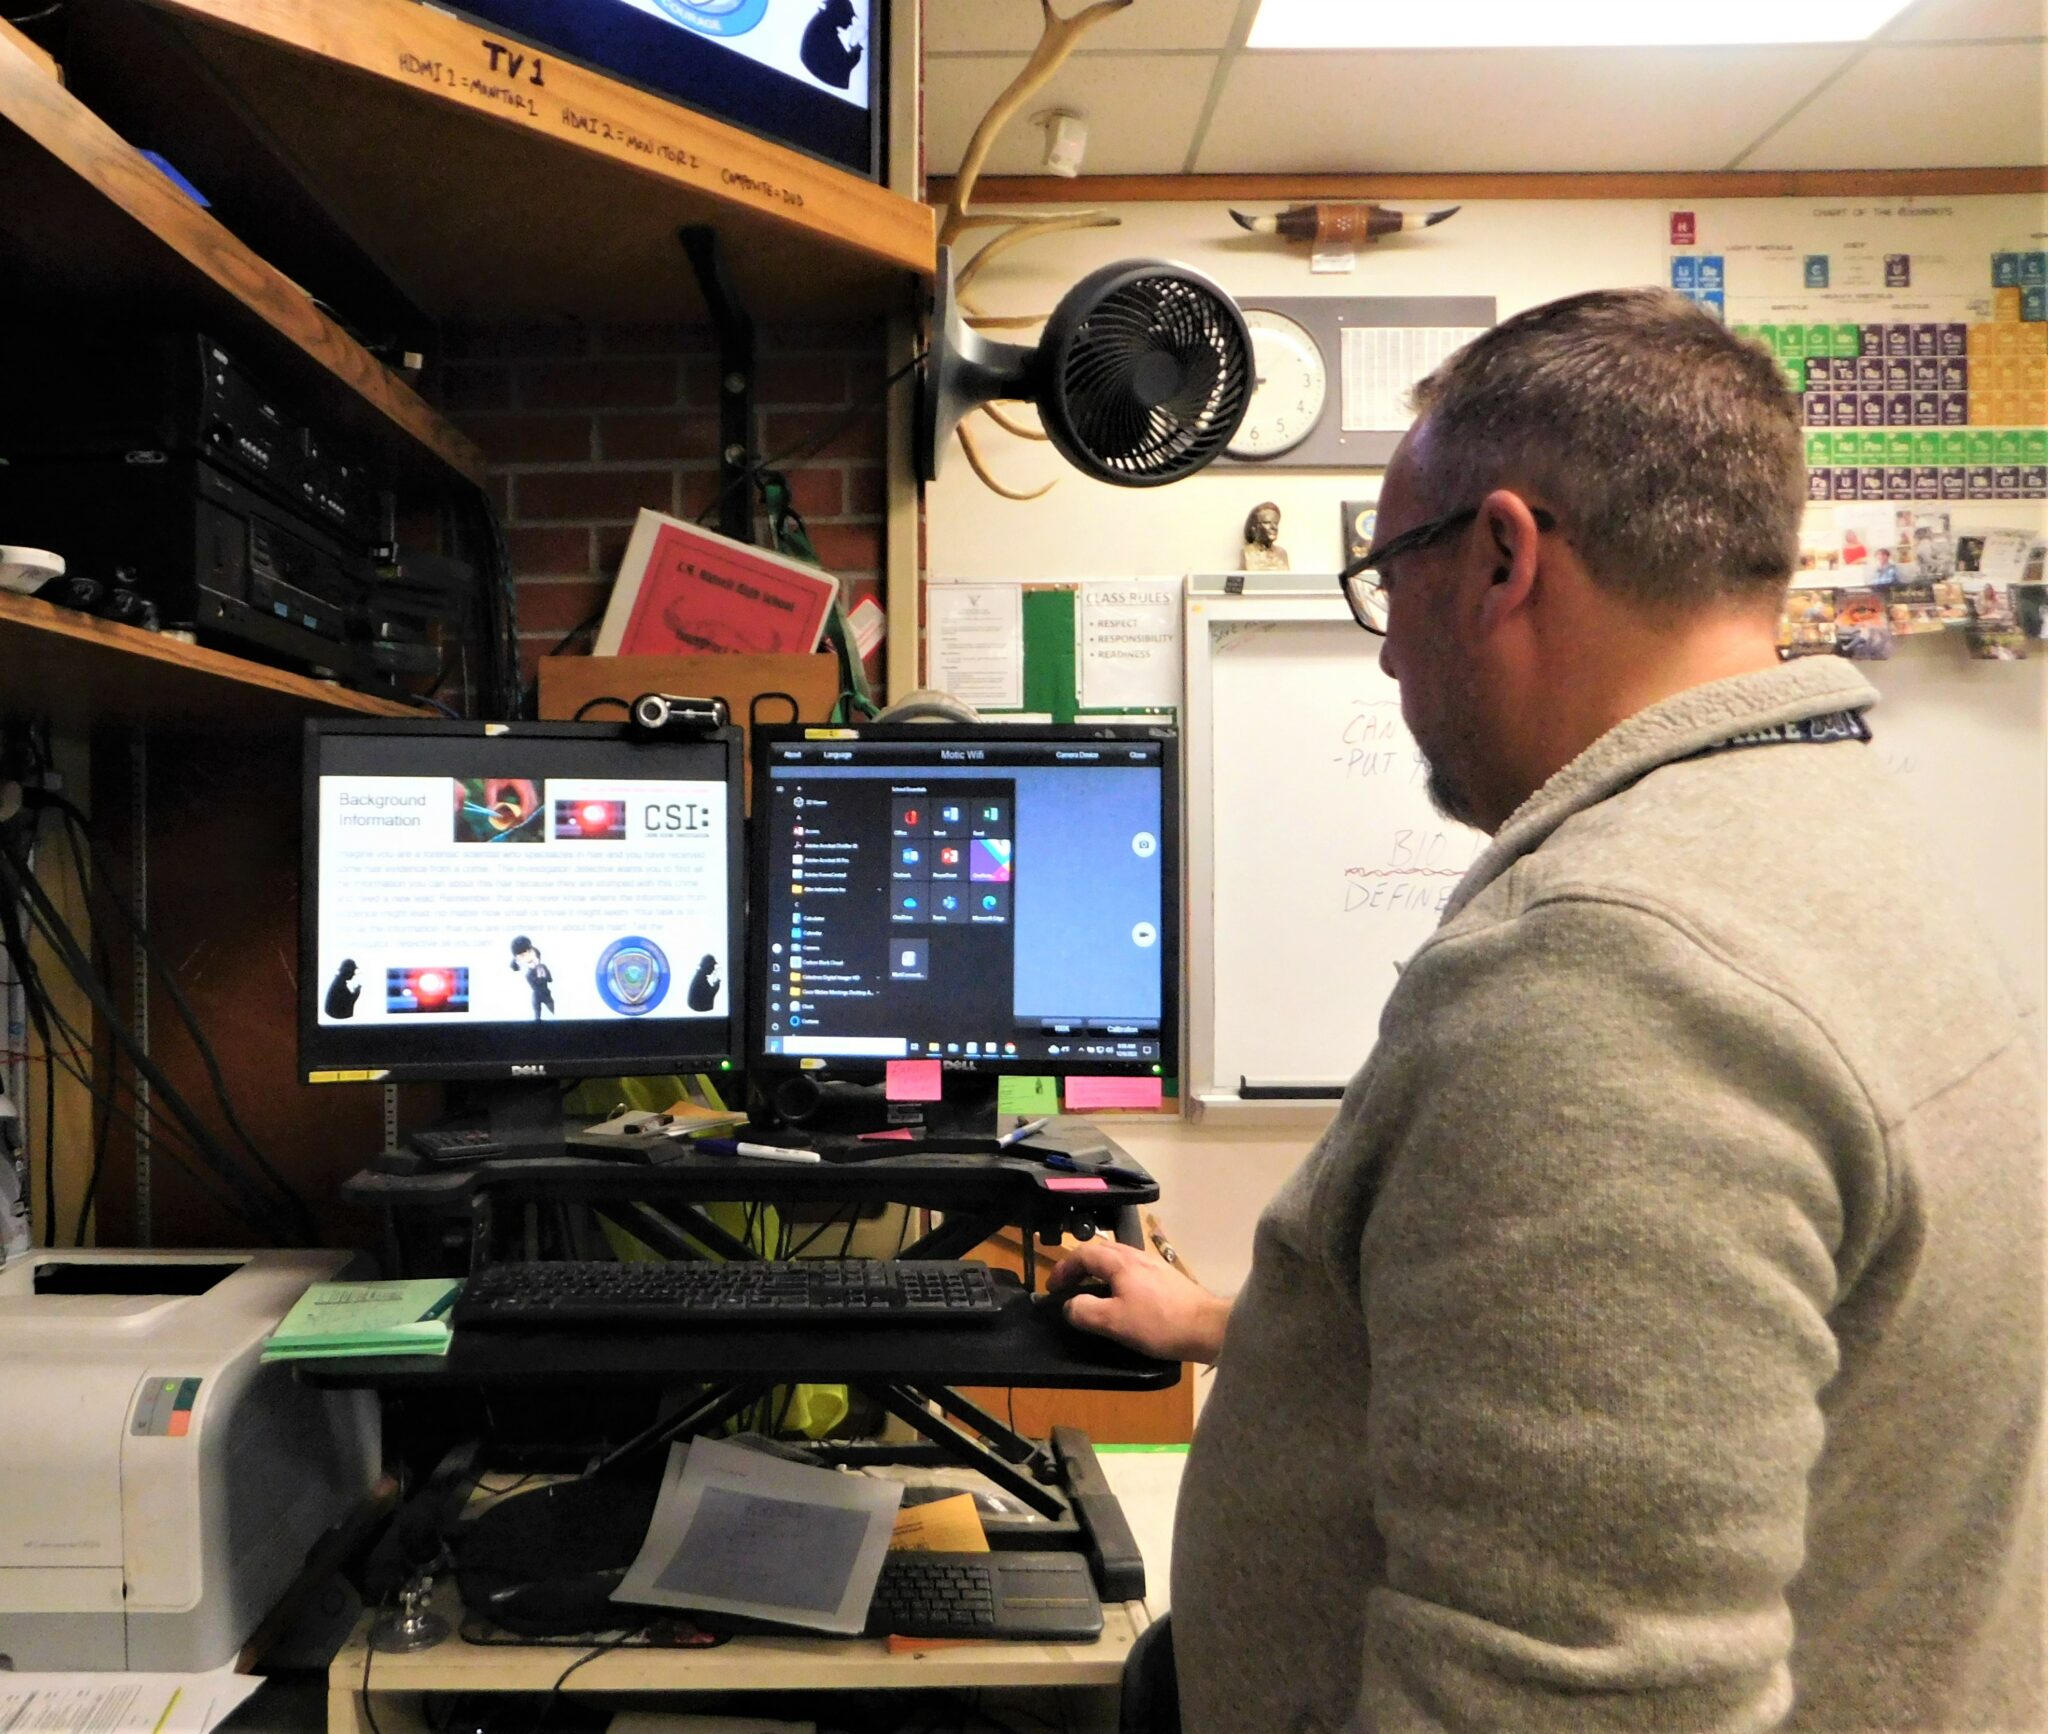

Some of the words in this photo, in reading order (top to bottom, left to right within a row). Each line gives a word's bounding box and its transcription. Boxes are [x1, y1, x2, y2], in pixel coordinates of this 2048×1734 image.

[1303, 372, 1312, 388] 3
[1296, 399, 1305, 414] 4
[1275, 417, 1286, 433] 5
[1249, 425, 1260, 441] 6
[1086, 592, 1126, 604] CLASS
[1129, 592, 1171, 604] RULES
[1097, 619, 1137, 628] RESPECT
[1097, 634, 1173, 643] RESPONSIBILITY
[1097, 650, 1151, 659] READINESS
[940, 749, 963, 760] Motic
[966, 749, 985, 760] Wifi
[339, 792, 426, 809] Background
[339, 813, 421, 827] Information
[644, 803, 711, 831] CSI:
[511, 1065, 546, 1076] DELL
[943, 1060, 977, 1071] DELL
